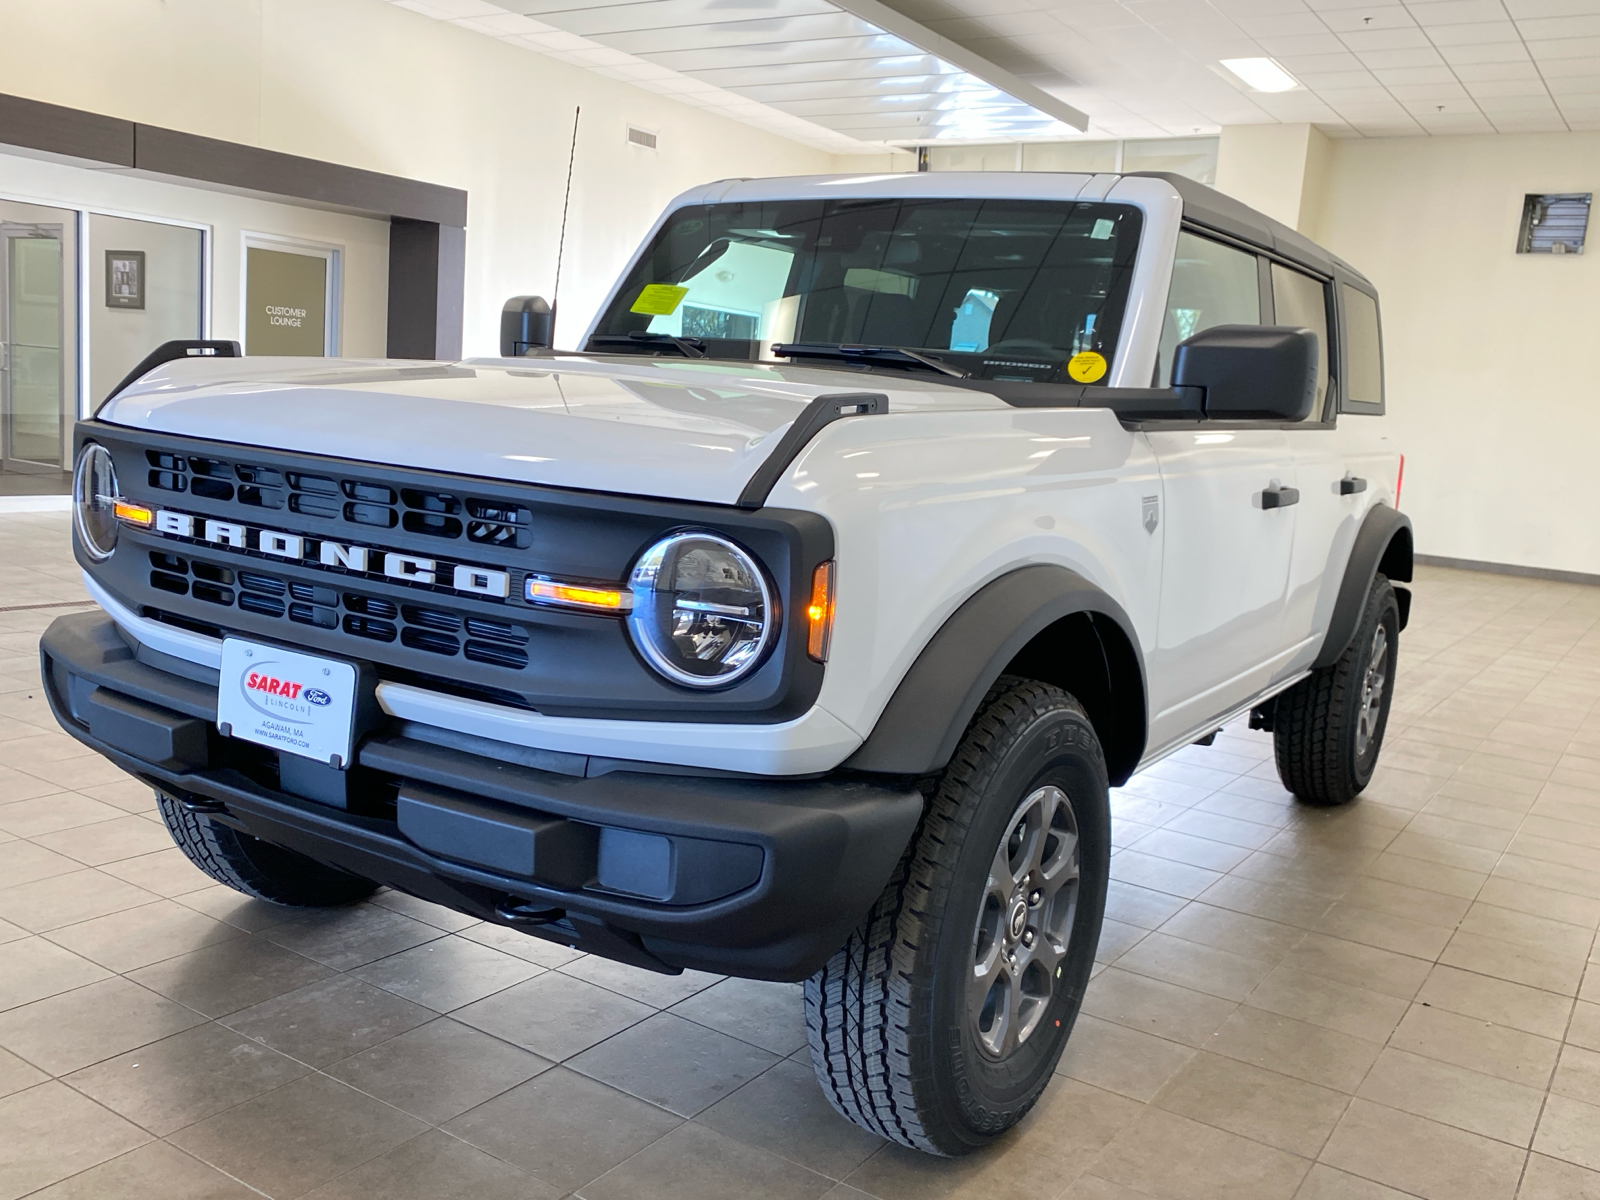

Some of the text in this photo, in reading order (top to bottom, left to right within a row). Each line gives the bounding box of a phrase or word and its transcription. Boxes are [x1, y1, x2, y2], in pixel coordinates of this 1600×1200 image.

[265, 305, 306, 318] CUSTOMER
[270, 316, 301, 327] LOUNGE
[156, 509, 510, 598] BRONCO
[246, 673, 302, 699] SARAT
[270, 698, 305, 713] LINCOLN
[305, 689, 328, 706] Ford
[261, 720, 304, 738] AGAWAM, MA
[254, 728, 310, 748] WWW.SARATFORD.COM
